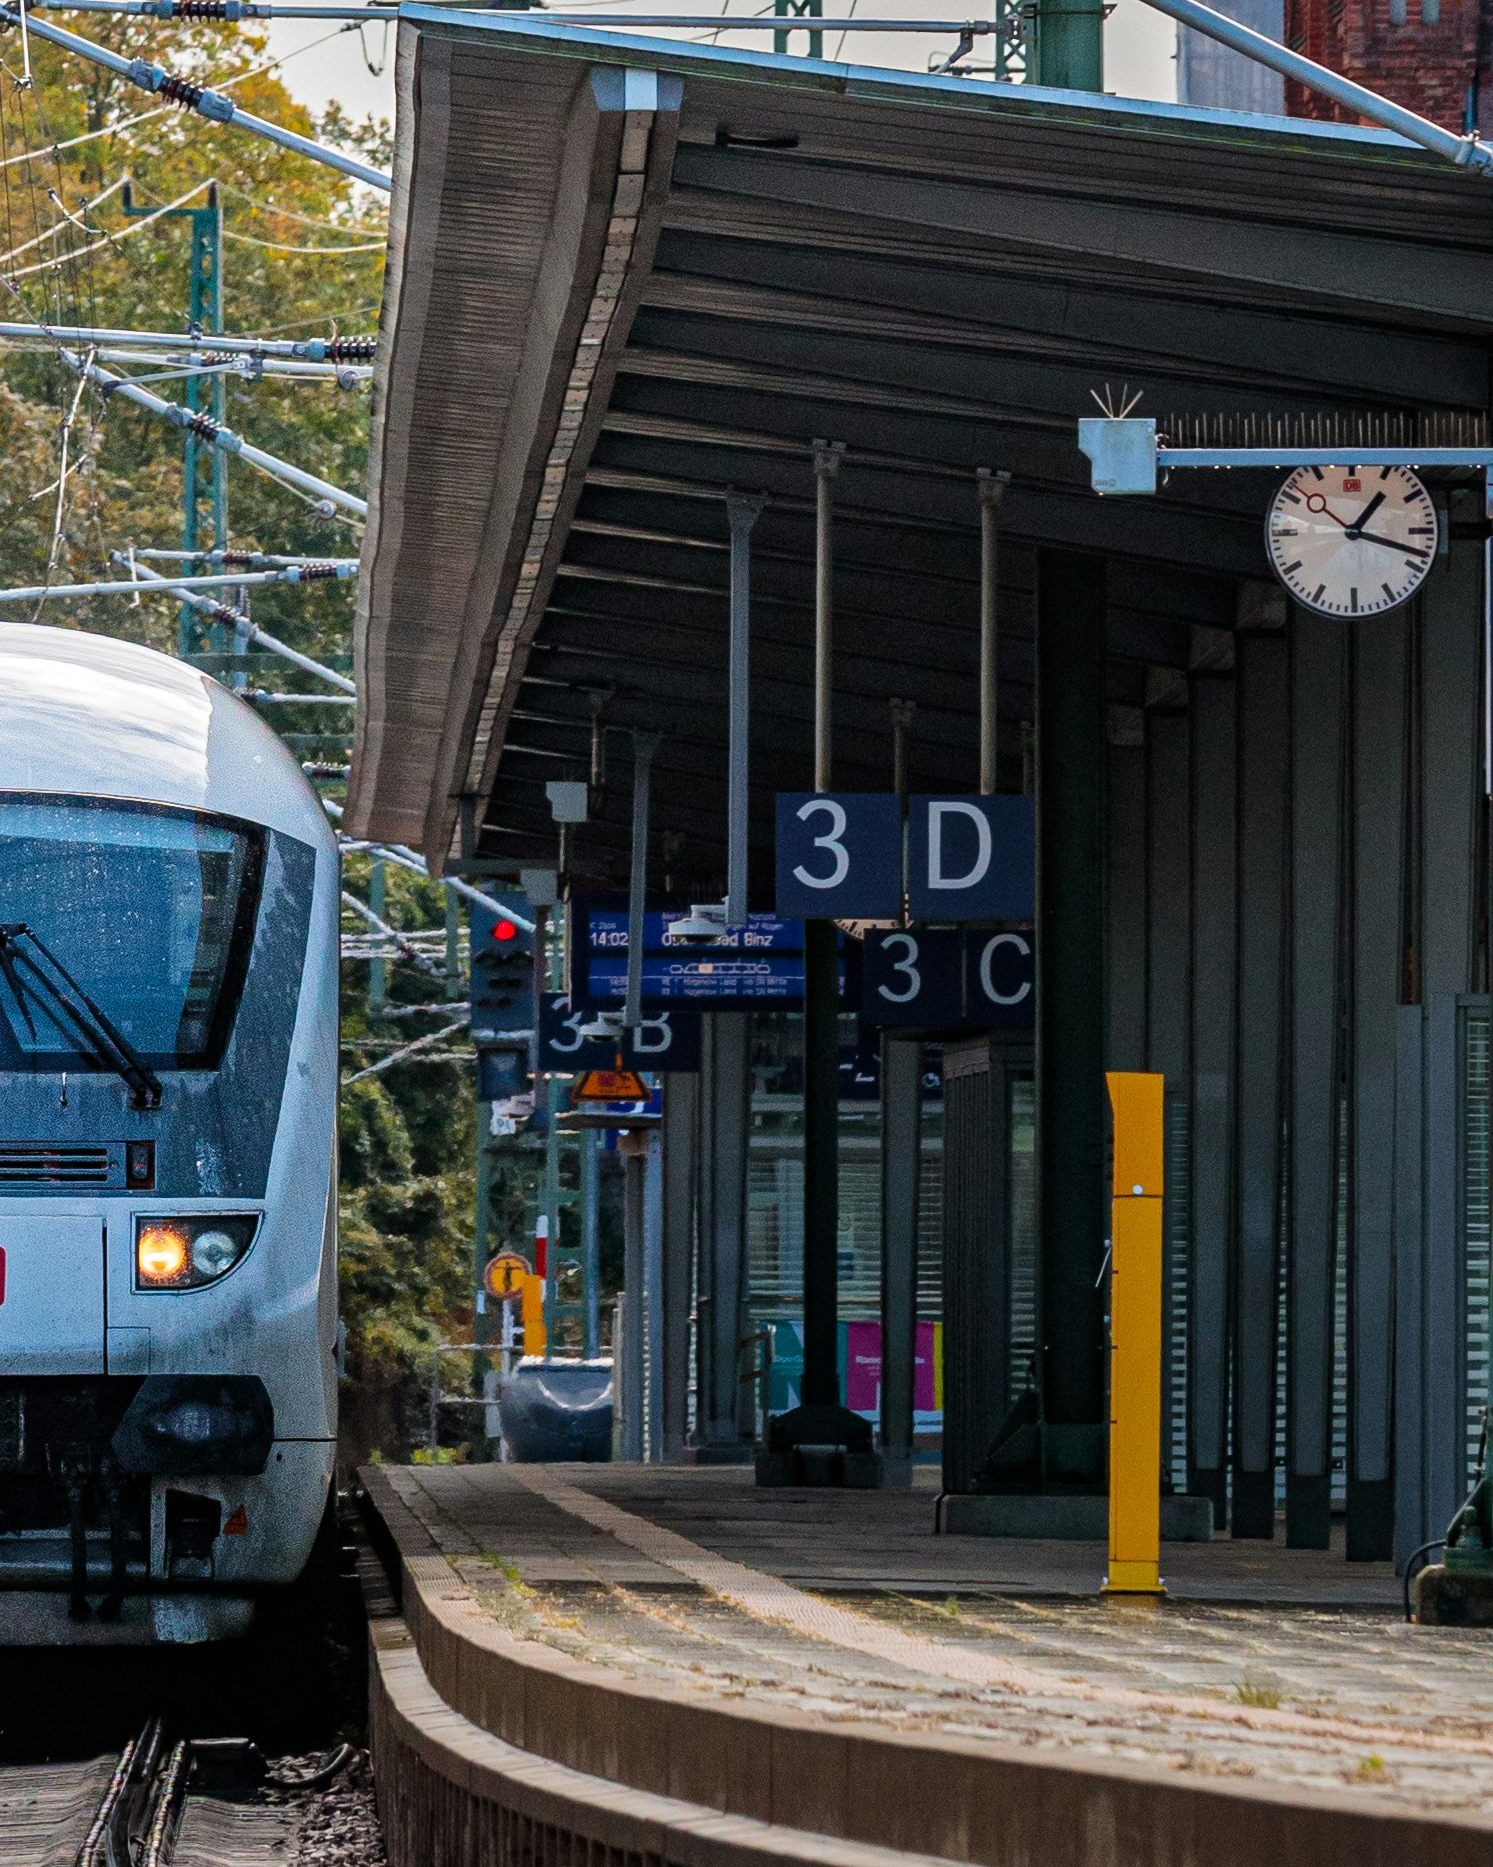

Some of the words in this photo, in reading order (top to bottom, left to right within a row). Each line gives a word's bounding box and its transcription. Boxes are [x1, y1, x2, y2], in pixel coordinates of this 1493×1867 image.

[793, 799, 850, 889] 3
[928, 802, 992, 890] D
[589, 932, 629, 946] 14:02
[744, 932, 774, 946] Binz
[878, 934, 921, 1003] 3
[982, 934, 1034, 1005] C
